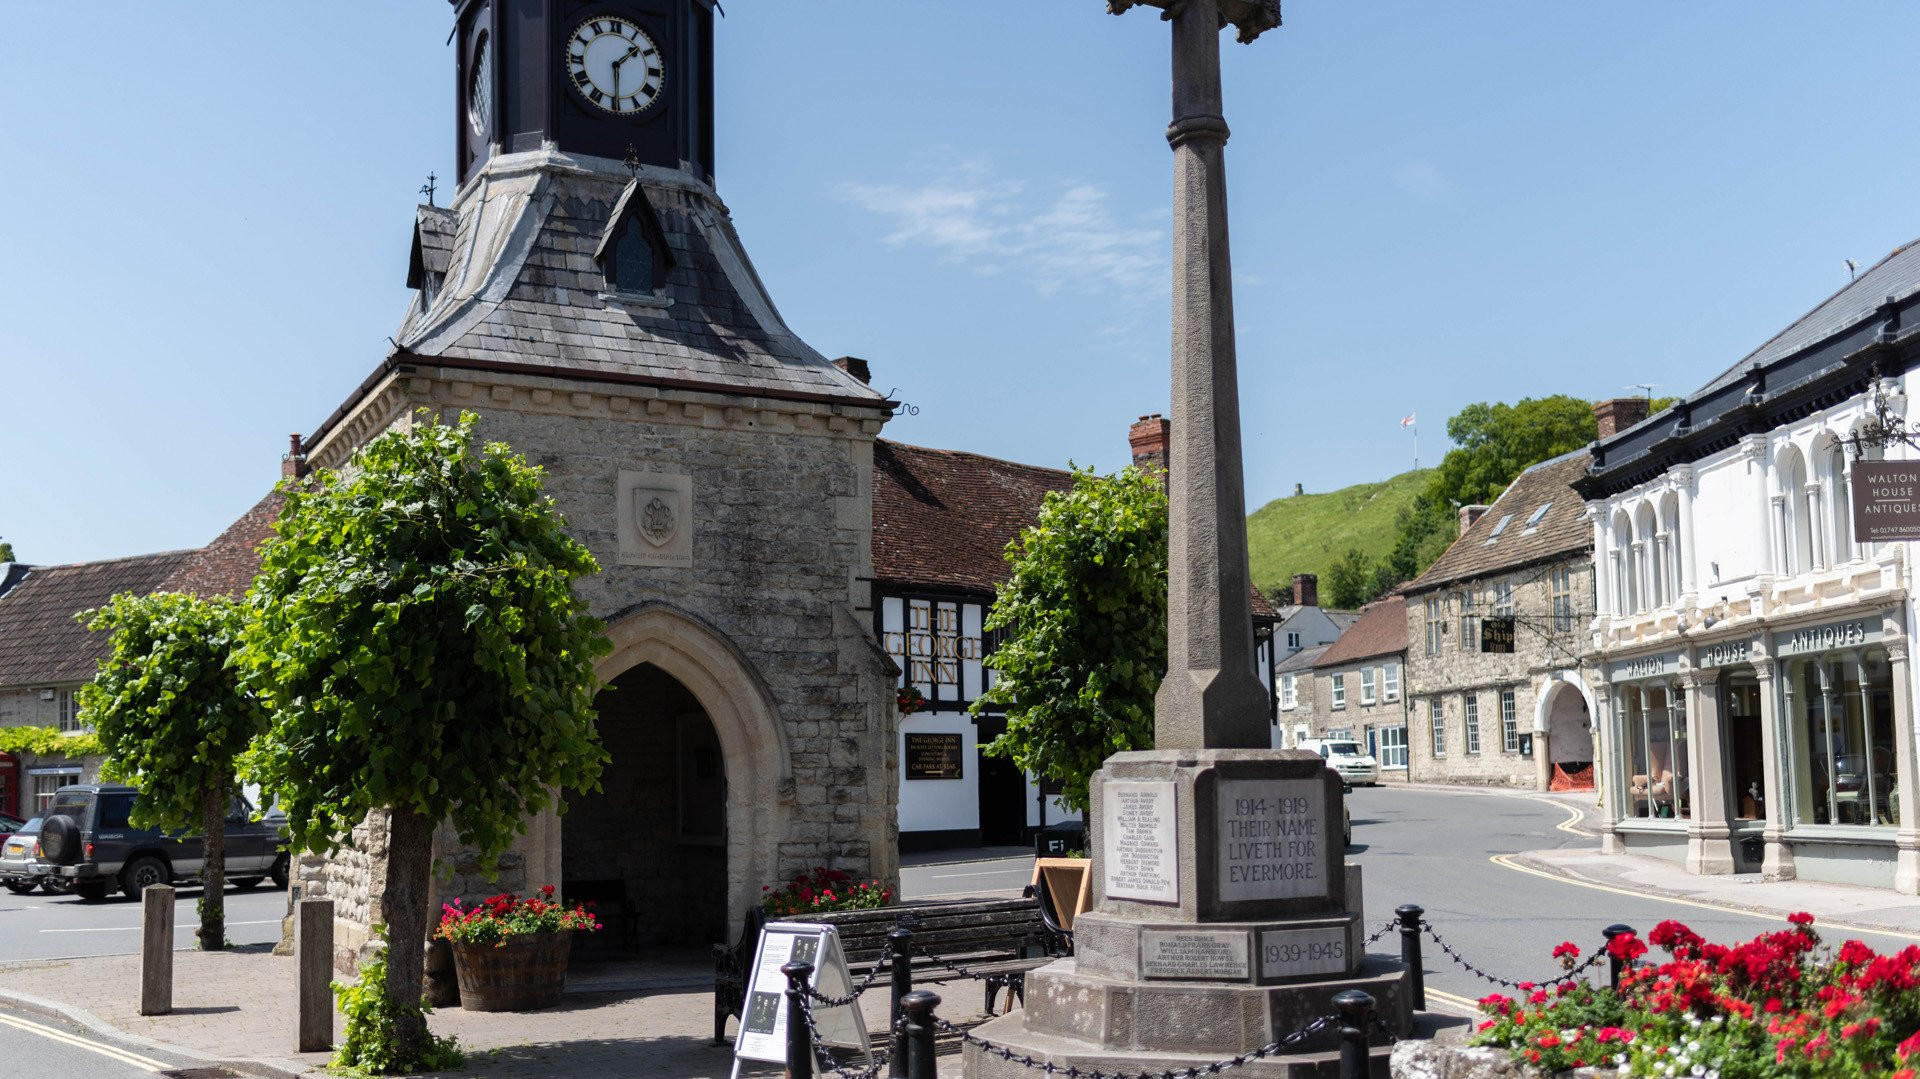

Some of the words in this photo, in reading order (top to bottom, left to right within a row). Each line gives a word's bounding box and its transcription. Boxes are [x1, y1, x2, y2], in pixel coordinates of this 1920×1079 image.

[1868, 474, 1916, 483] WALTON
[1872, 488, 1912, 496] HOUSE
[910, 607, 957, 632] THE
[1483, 628, 1512, 644] Ship
[885, 632, 982, 660] GEORGE
[1626, 658, 1663, 677] WALTON
[1707, 642, 1745, 663] HOUSE
[1792, 623, 1864, 648] ANTIQUES
[911, 660, 958, 686] INN
[1228, 820, 1270, 838] THEIR
[1277, 819, 1316, 836] NAME
[1229, 842, 1282, 860] LIVETH
[1288, 841, 1316, 857] FOR
[1230, 863, 1317, 882] EVERMORE.
